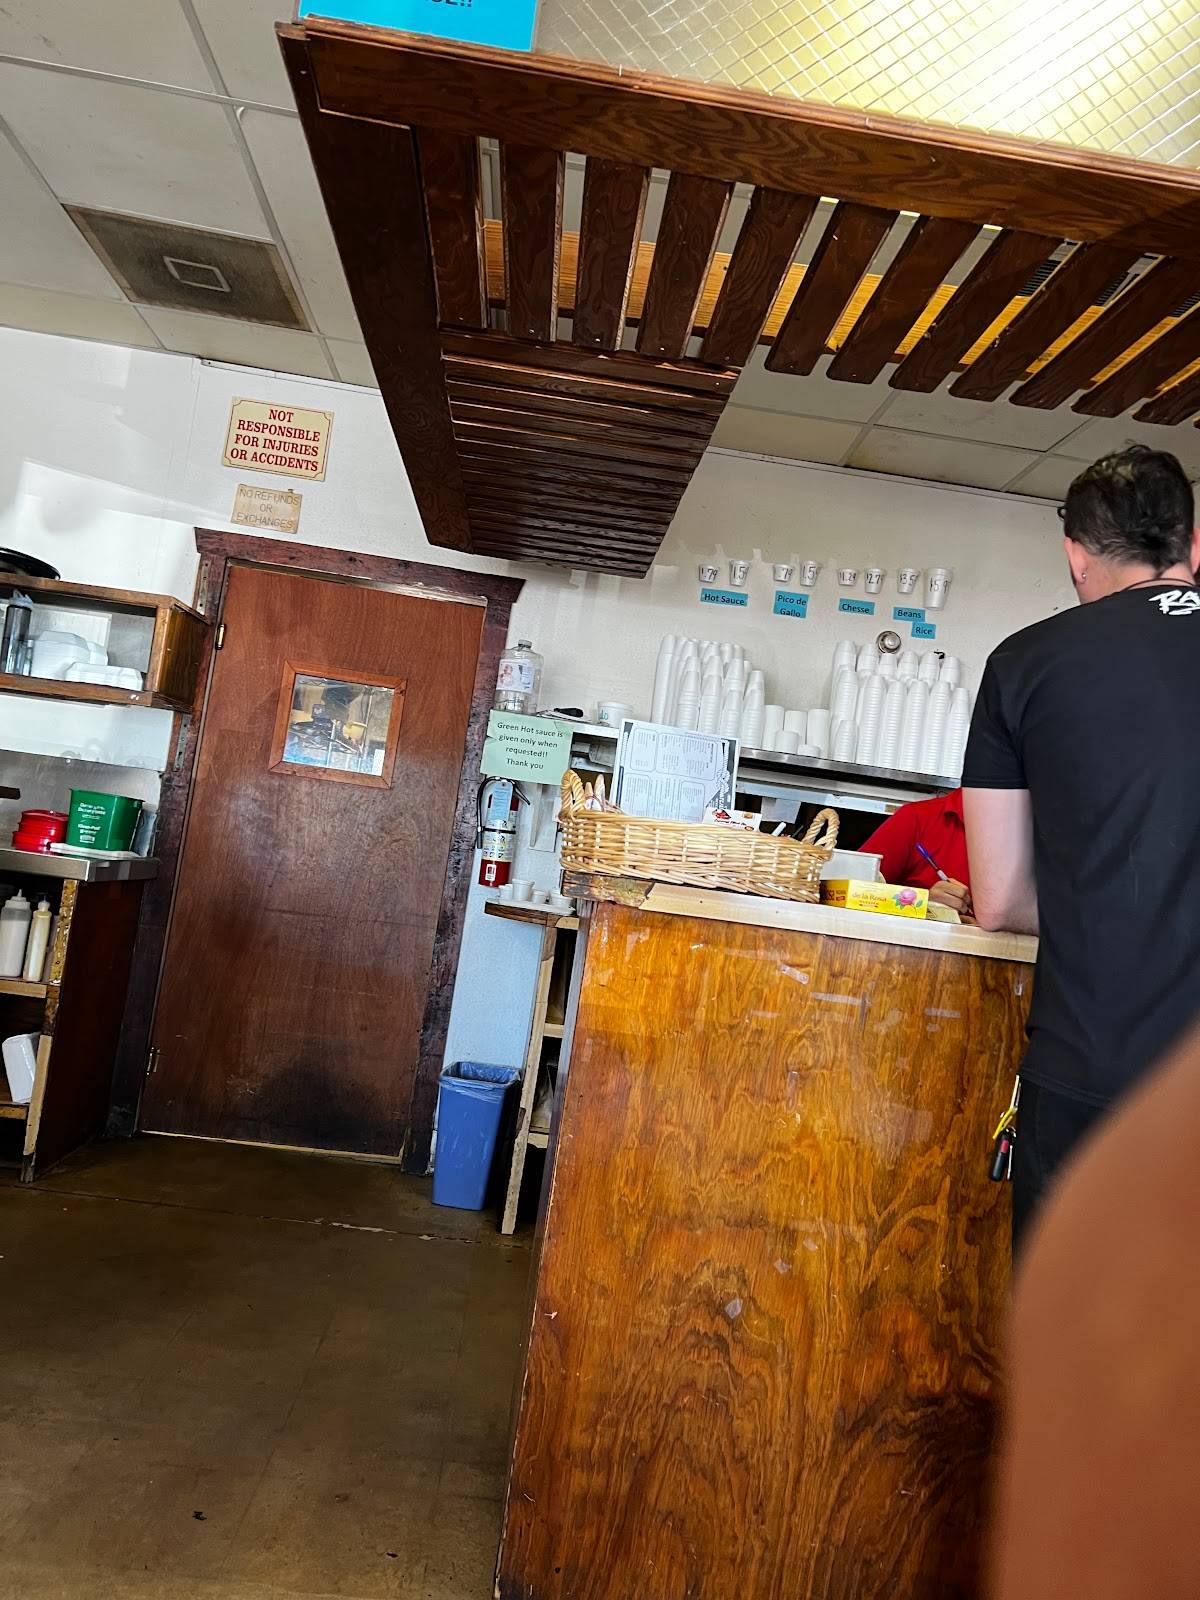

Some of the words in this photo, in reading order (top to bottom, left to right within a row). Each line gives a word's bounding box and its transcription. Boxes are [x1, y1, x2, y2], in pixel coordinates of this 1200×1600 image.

[268, 408, 294, 423] NOT
[237, 419, 321, 442] RESPONSIBLE
[234, 433, 259, 447] FOR
[262, 438, 319, 457] INJURIES
[230, 448, 248, 460] OR
[251, 451, 319, 472] ACCIDENTS
[239, 486, 253, 498] NO
[254, 490, 300, 506] REFUNDS
[259, 503, 273, 513] OR
[236, 511, 294, 529] EXCHANGES
[704, 593, 719, 602] Hot
[720, 595, 745, 606] Sauce
[777, 594, 795, 604] Pico
[796, 597, 807, 606] de
[780, 608, 801, 617] Gallo
[842, 603, 870, 614] Chesse
[897, 609, 921, 619] Beans
[915, 626, 933, 635] Rice
[497, 721, 519, 731] Green
[520, 725, 534, 734] Hot
[535, 728, 556, 738] sauce
[498, 733, 519, 742] given
[520, 738, 536, 746] only
[537, 740, 558, 748] when
[505, 747, 548, 758] requested!!
[506, 758, 528, 767] Thank
[530, 762, 544, 770] you
